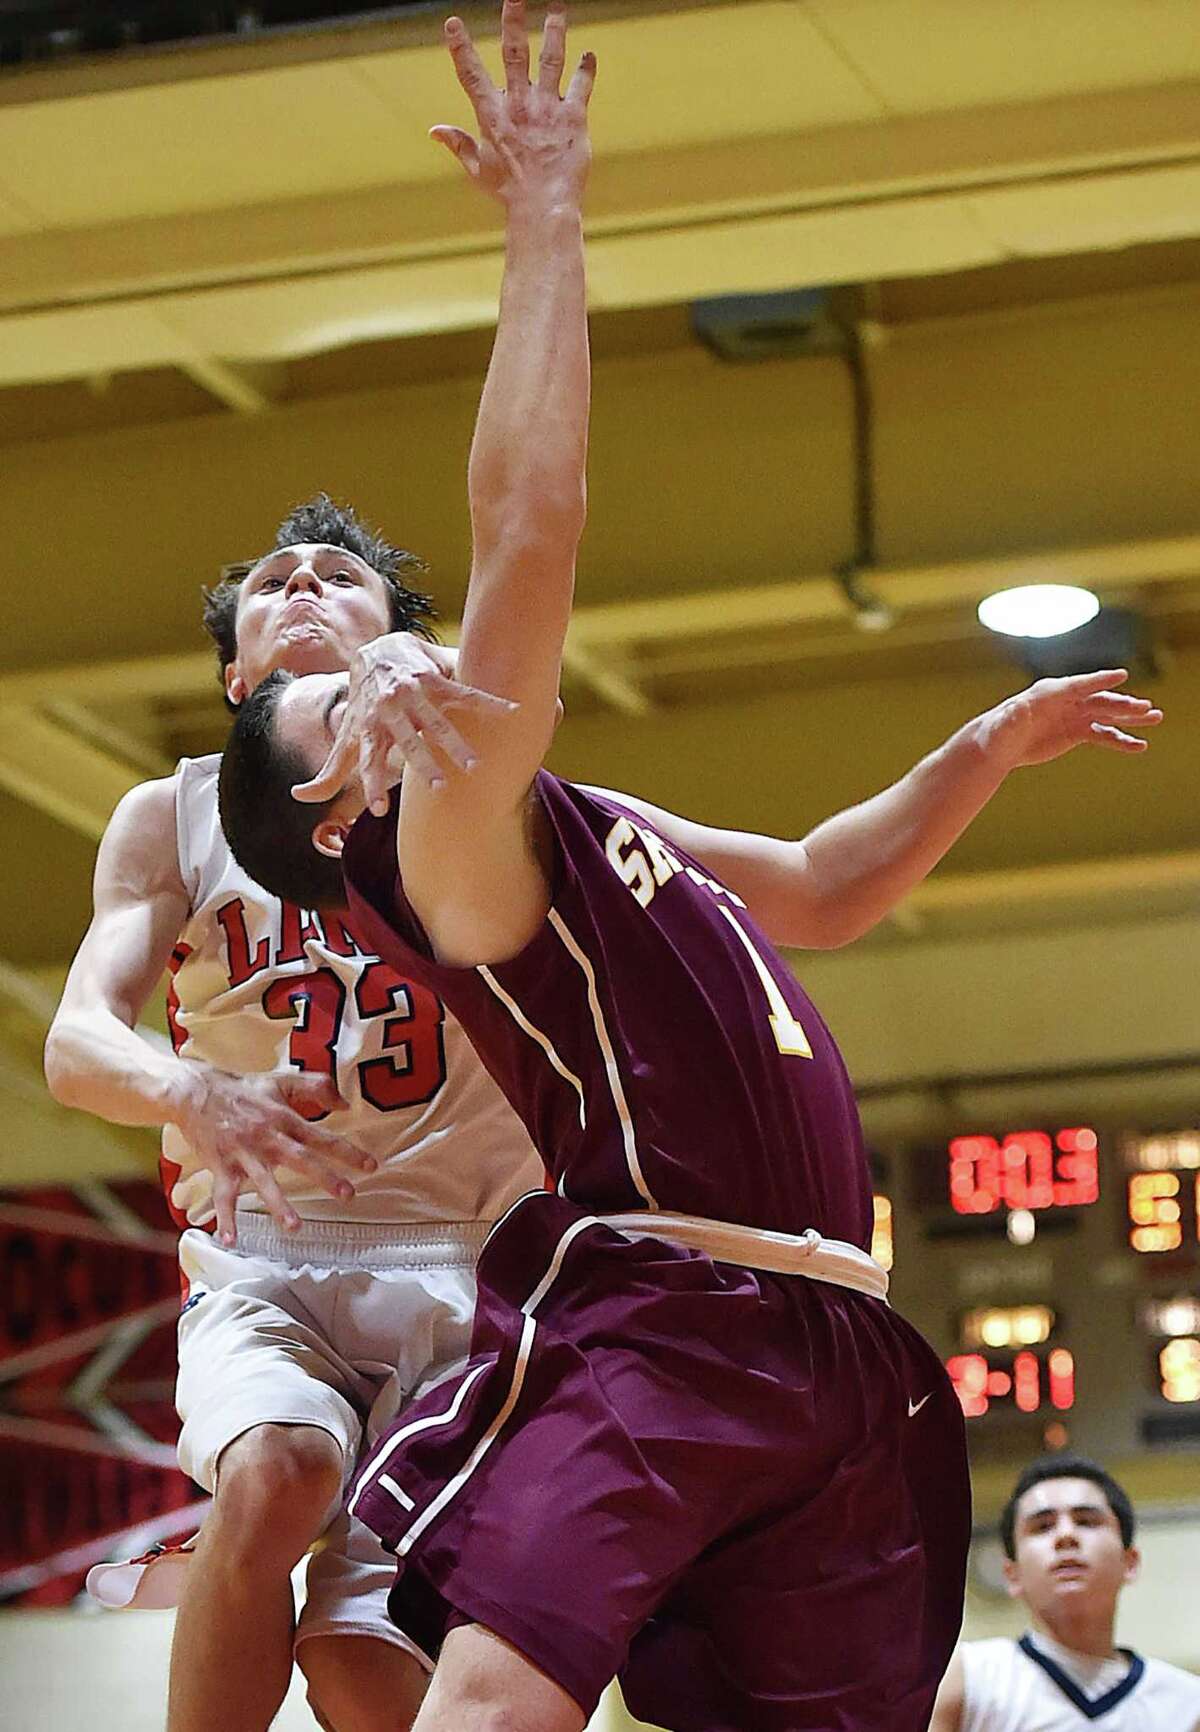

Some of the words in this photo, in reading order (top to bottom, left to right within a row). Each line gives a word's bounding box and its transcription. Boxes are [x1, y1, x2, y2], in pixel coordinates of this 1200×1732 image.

[262, 961, 447, 1122] 33
[715, 903, 814, 1060] 1
[1128, 1170, 1200, 1253] 5
